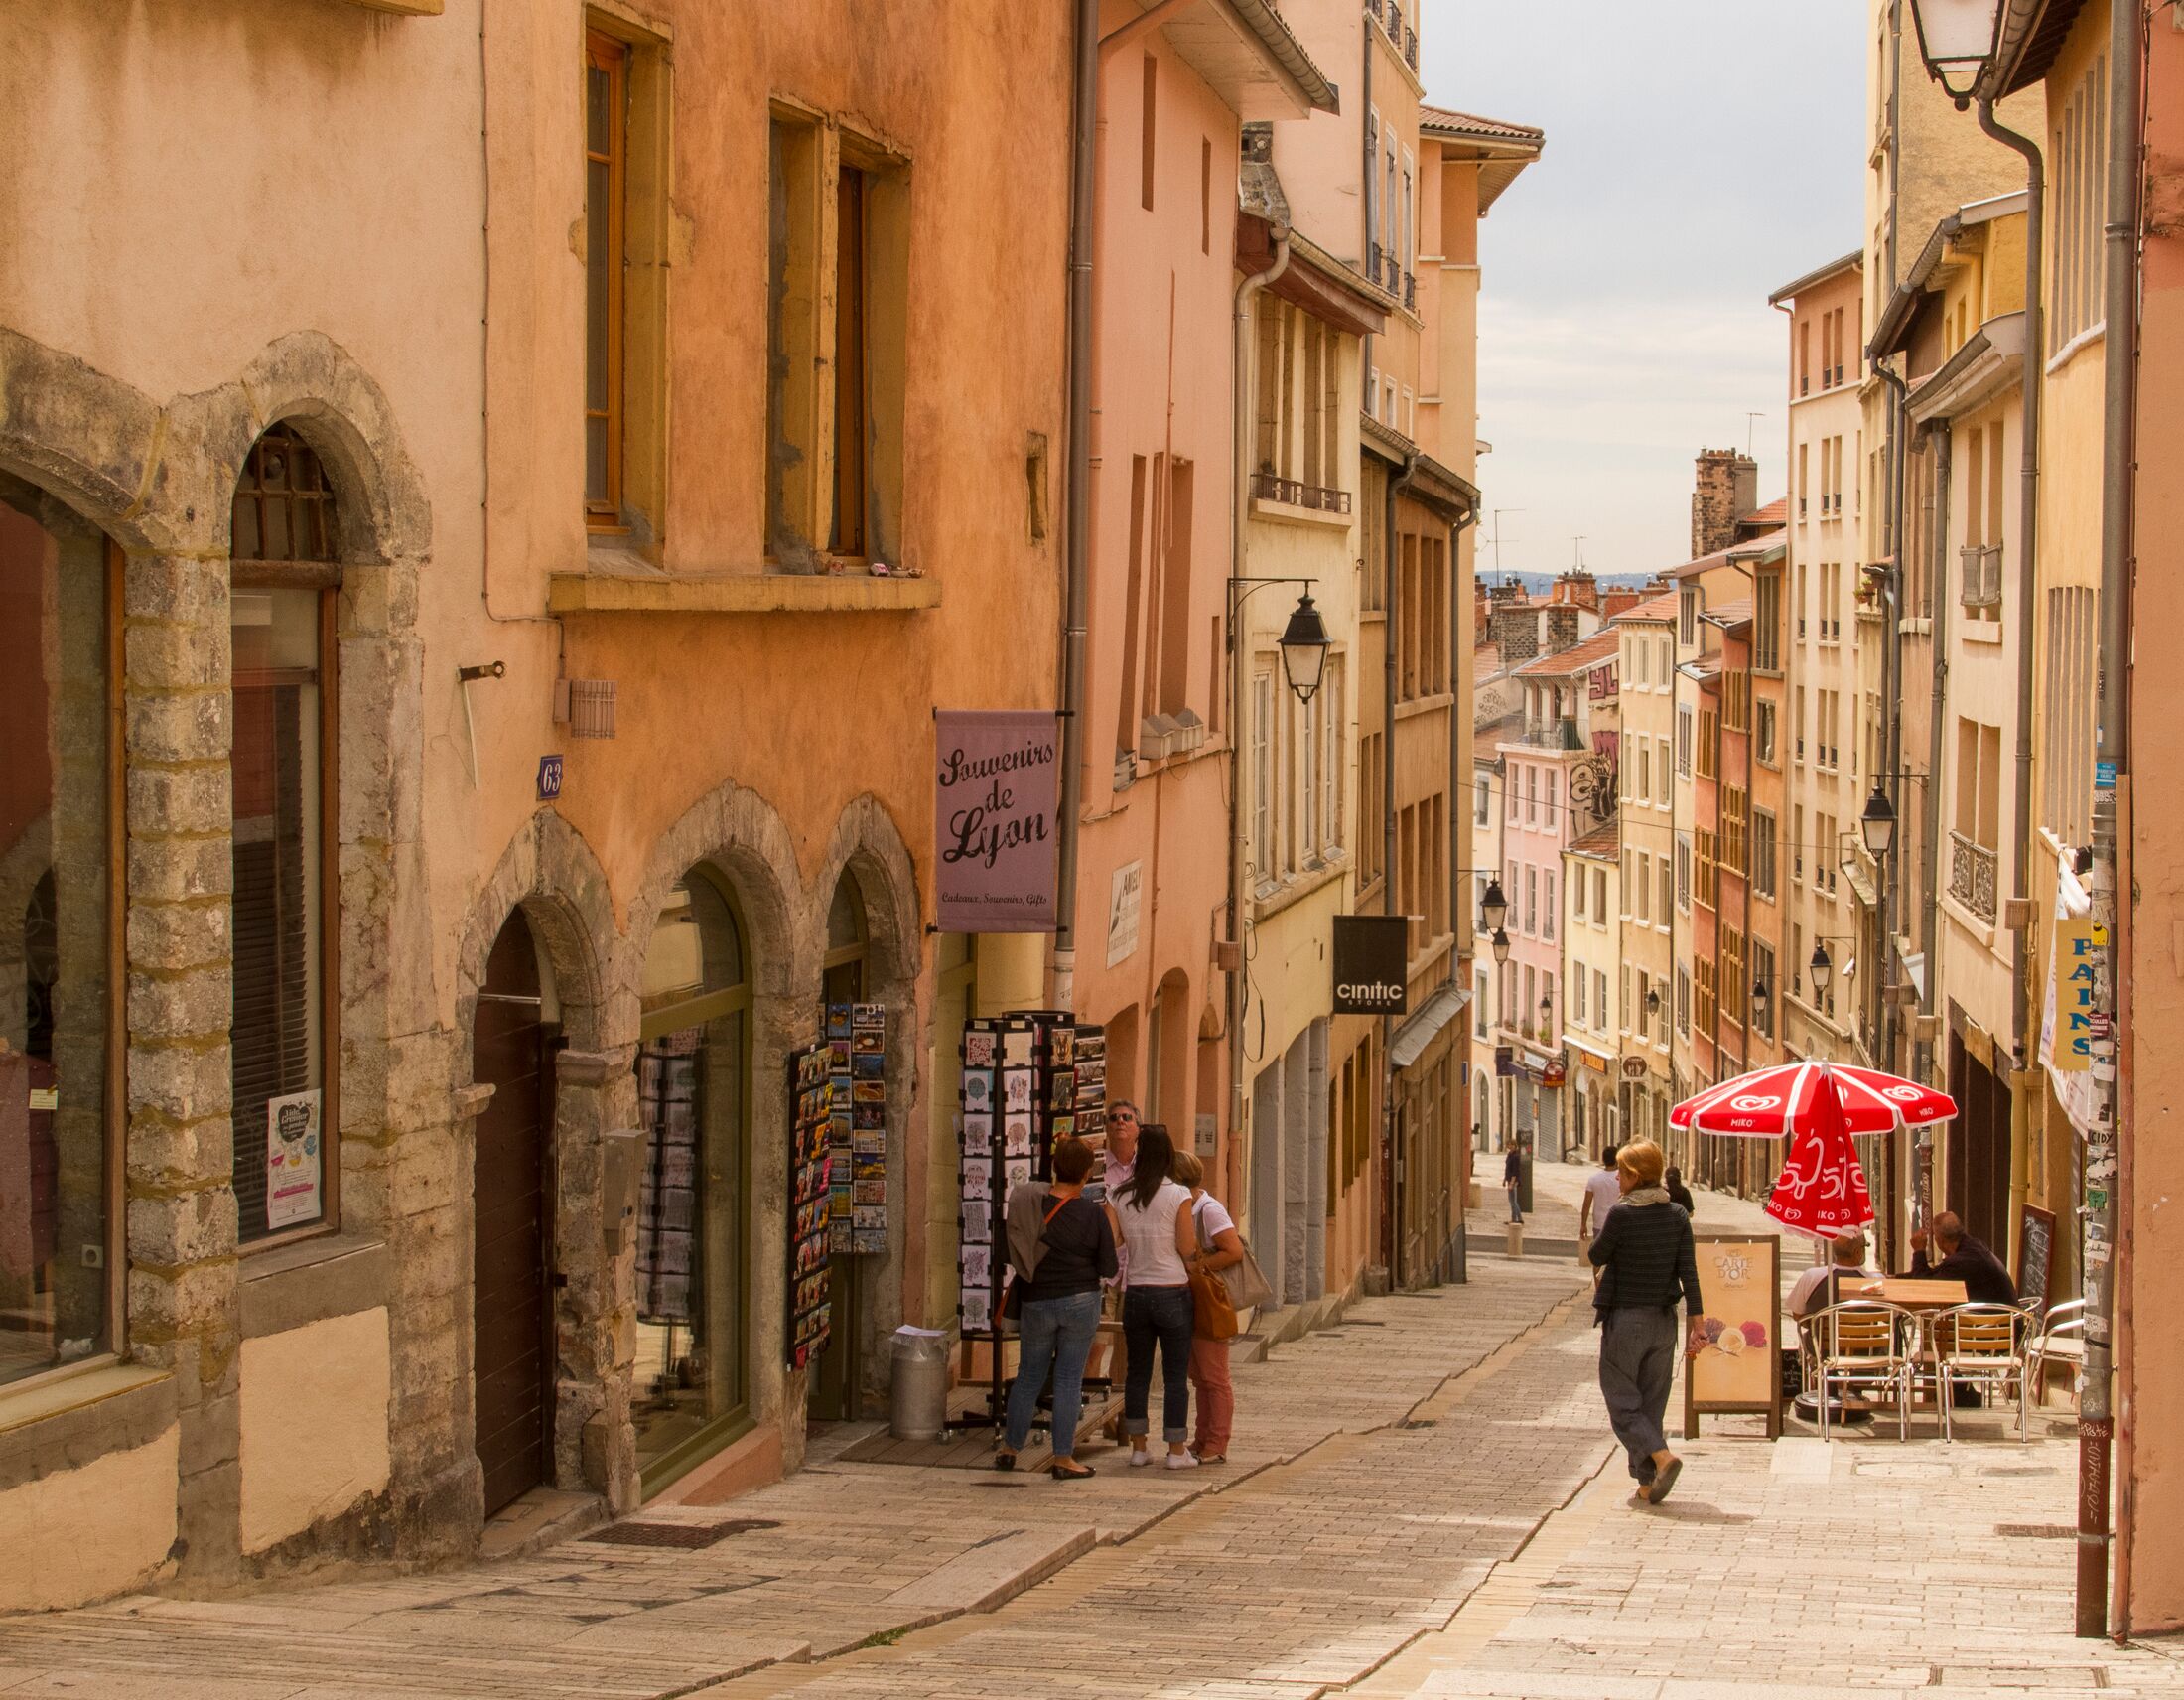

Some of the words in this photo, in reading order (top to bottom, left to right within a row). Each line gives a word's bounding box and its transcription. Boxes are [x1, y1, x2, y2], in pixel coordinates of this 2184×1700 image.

[939, 741, 1053, 787] Souvenirs
[543, 763, 562, 793] 63
[984, 779, 1015, 813] de
[942, 806, 1048, 869] Lyon
[941, 892, 982, 905] Cadeaux,
[983, 893, 1024, 906] Souvenirs,
[1025, 893, 1047, 907] Gifts
[1336, 980, 1403, 999] cinitic
[1730, 1117, 1753, 1128] MIKO
[1767, 1199, 1783, 1212] IKO
[1817, 1209, 1836, 1221] IKO
